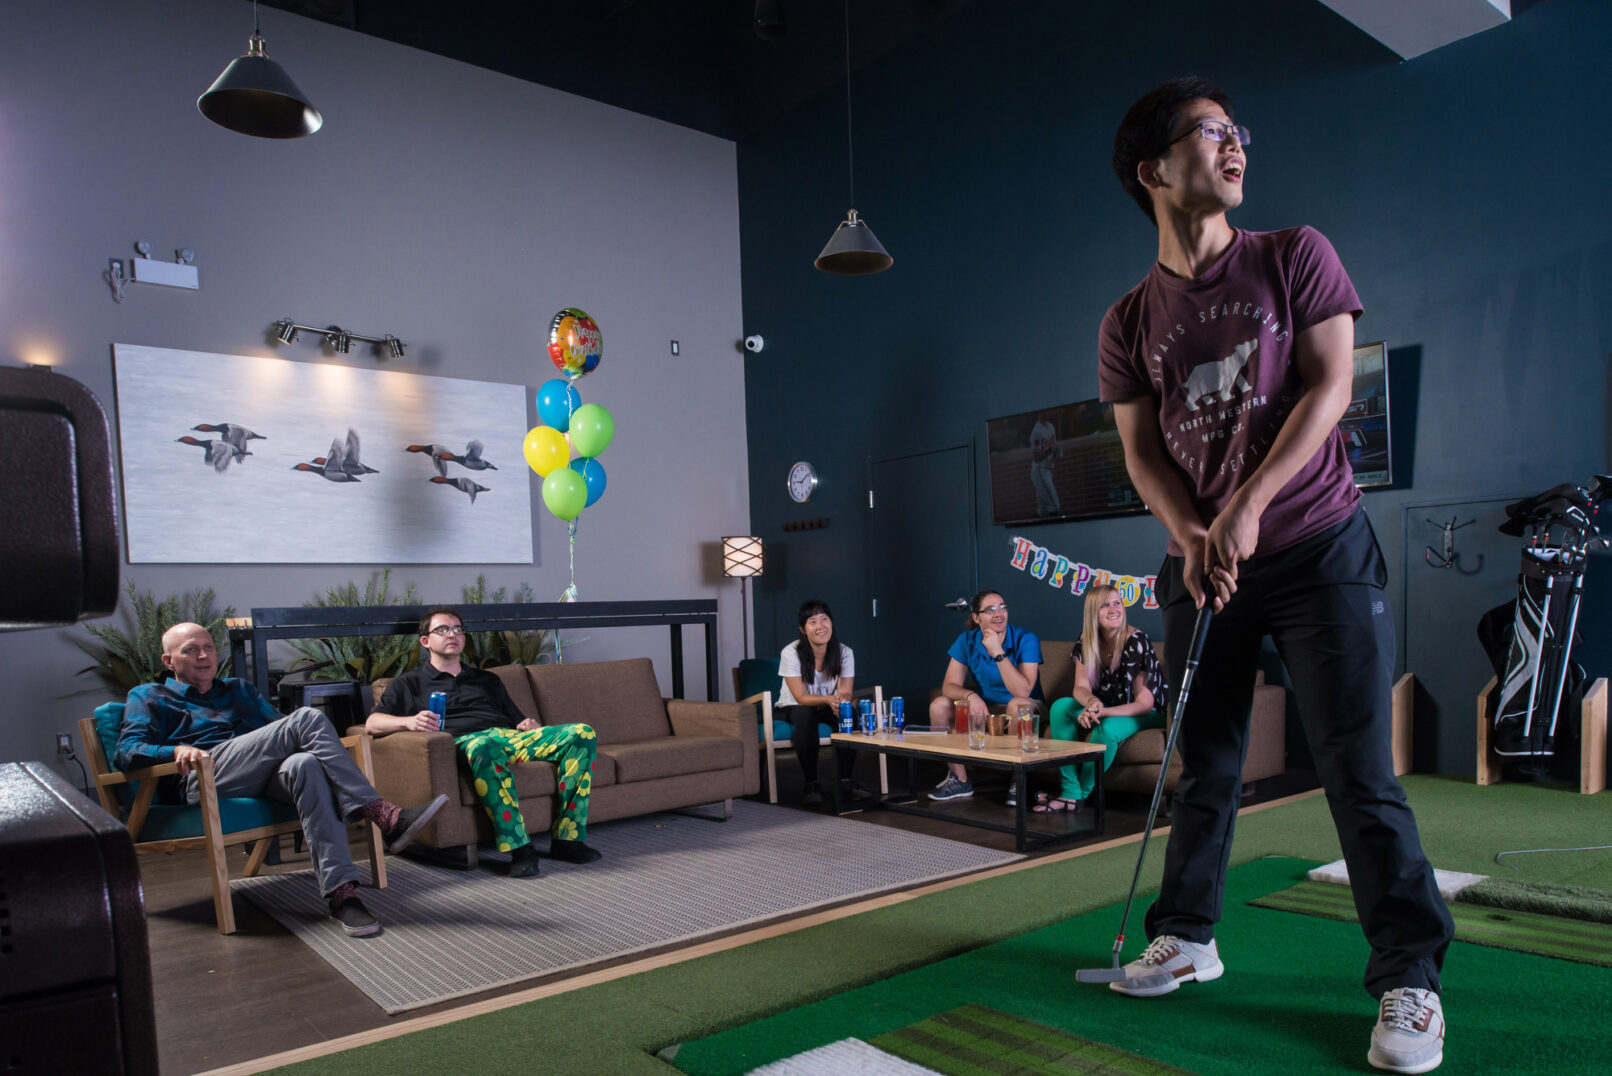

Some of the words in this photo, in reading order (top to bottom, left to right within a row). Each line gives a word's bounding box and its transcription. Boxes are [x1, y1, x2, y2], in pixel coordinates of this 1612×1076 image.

[1199, 302, 1289, 342] SEARCHING
[1179, 413, 1212, 432] NORTH
[1218, 395, 1268, 420] WESTERN
[1202, 429, 1225, 443] MFG
[1119, 581, 1134, 602] 50
